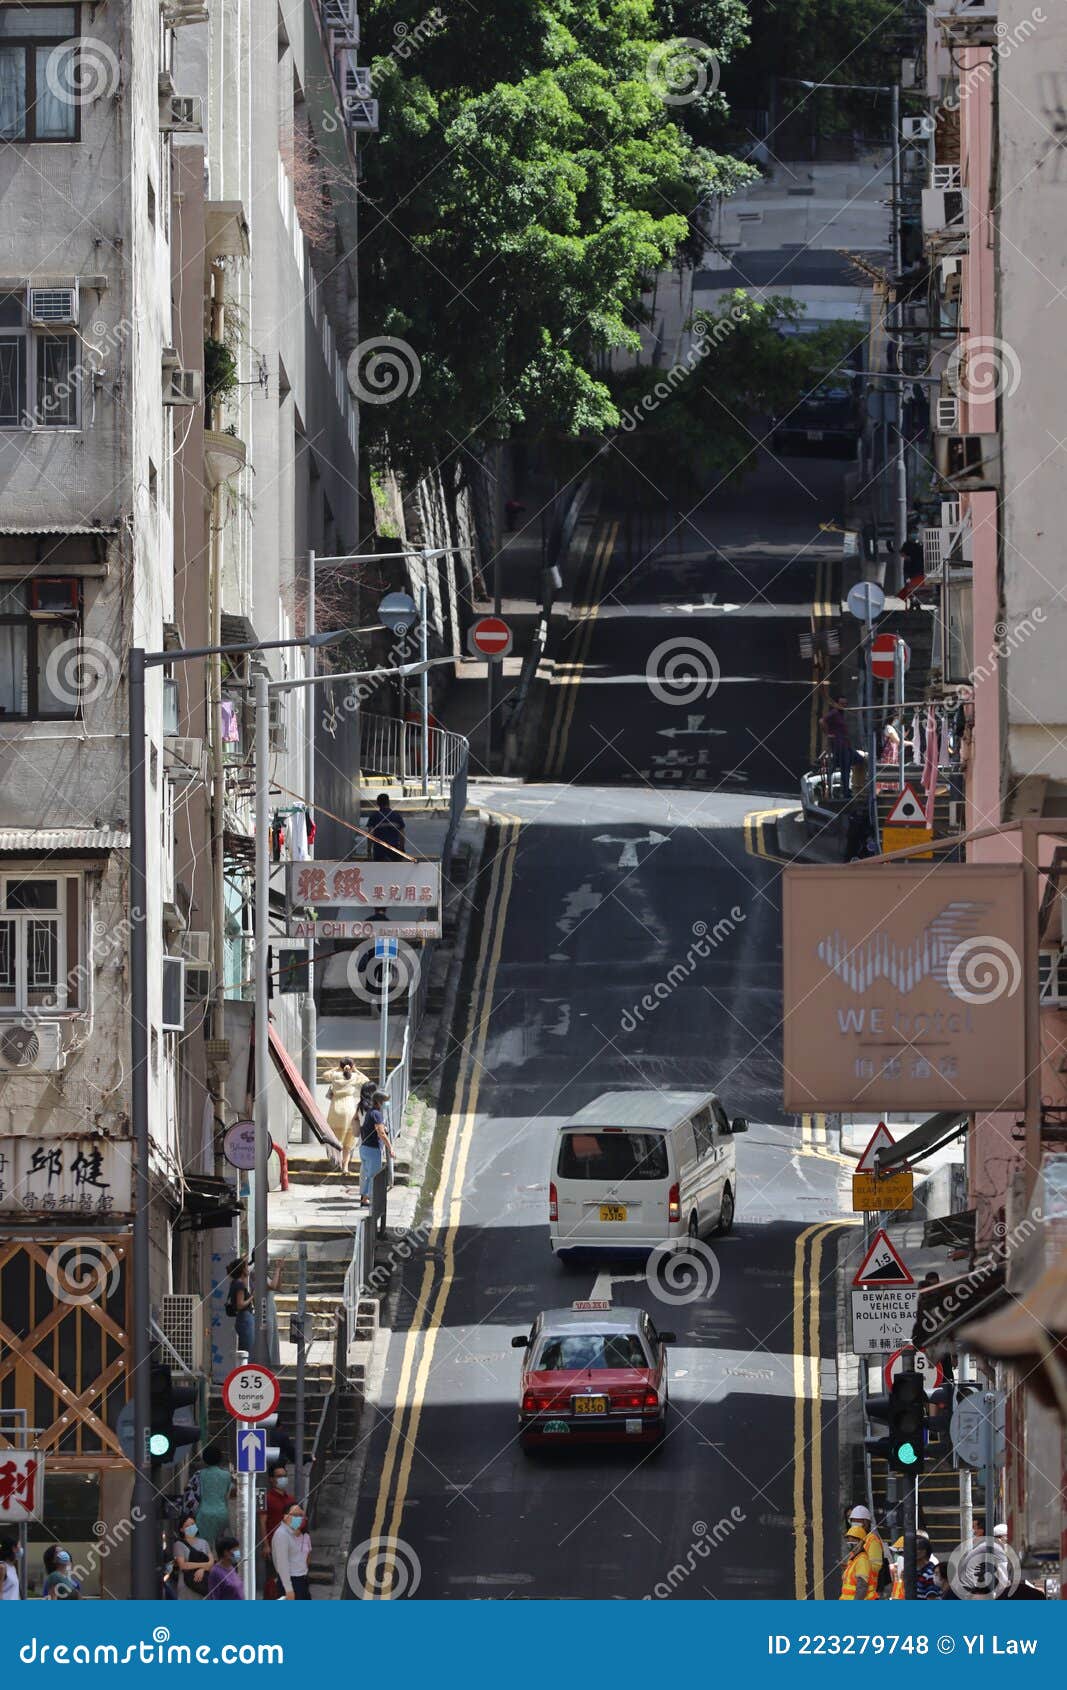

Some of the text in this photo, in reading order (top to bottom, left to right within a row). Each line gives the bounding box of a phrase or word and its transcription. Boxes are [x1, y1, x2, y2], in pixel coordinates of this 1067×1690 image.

[295, 922, 315, 937] AH
[322, 922, 346, 937] CHI
[836, 1007, 974, 1034] WE hotel
[602, 1212, 624, 1221] 7315
[874, 1252, 892, 1268] 1:5
[862, 1292, 917, 1301] BEWARE OF
[869, 1302, 910, 1310] VEHICLE
[856, 1312, 898, 1320] ROLLING
[879, 1322, 903, 1334] 小心
[240, 1376, 263, 1389] 5.5
